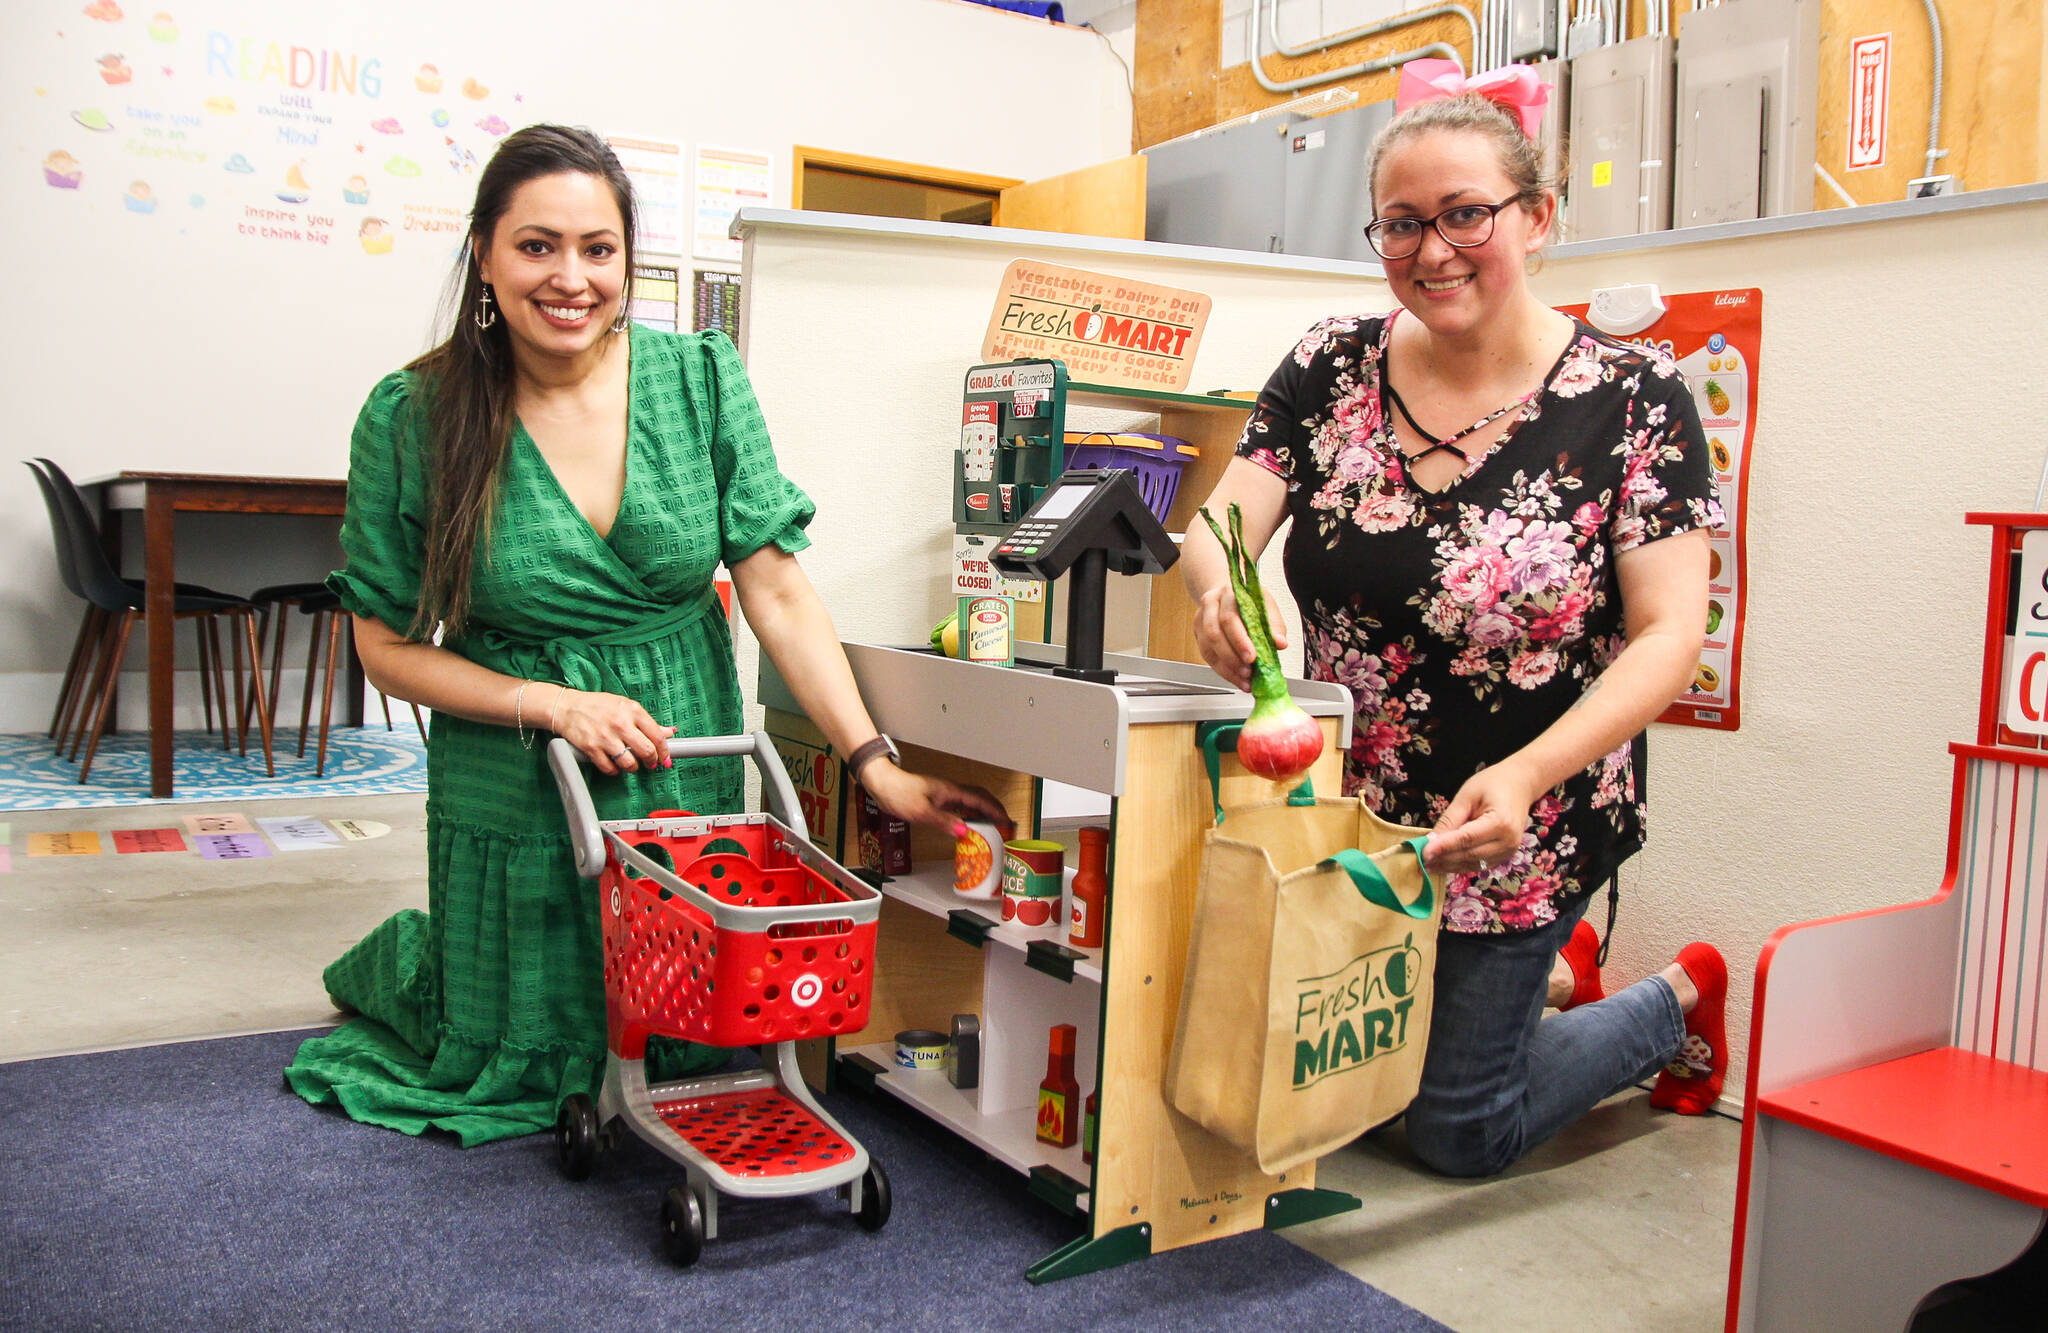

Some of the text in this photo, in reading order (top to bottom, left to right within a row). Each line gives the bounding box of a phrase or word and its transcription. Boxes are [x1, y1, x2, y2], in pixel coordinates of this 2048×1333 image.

[207, 29, 383, 98] READING
[245, 205, 334, 229] inspire you
[238, 222, 329, 245] to think big
[704, 272, 727, 283] SIGHT
[1016, 268, 1200, 314] Vegetables Dairy Deli
[1020, 283, 1186, 324] Fish Frozen Foods
[1001, 302, 1193, 357] Fresh MART
[1003, 332, 1174, 371] Fruit Canned Goods
[1018, 371, 1053, 386] Favorites
[1123, 366, 1177, 385] Snacks
[962, 560, 989, 573] WE'RE
[957, 575, 992, 590] CLOSED!
[971, 601, 1007, 612] GRATED
[1296, 961, 1385, 1034] Fresh
[1293, 996, 1414, 1085] MART
[911, 1050, 940, 1060] TUNA
